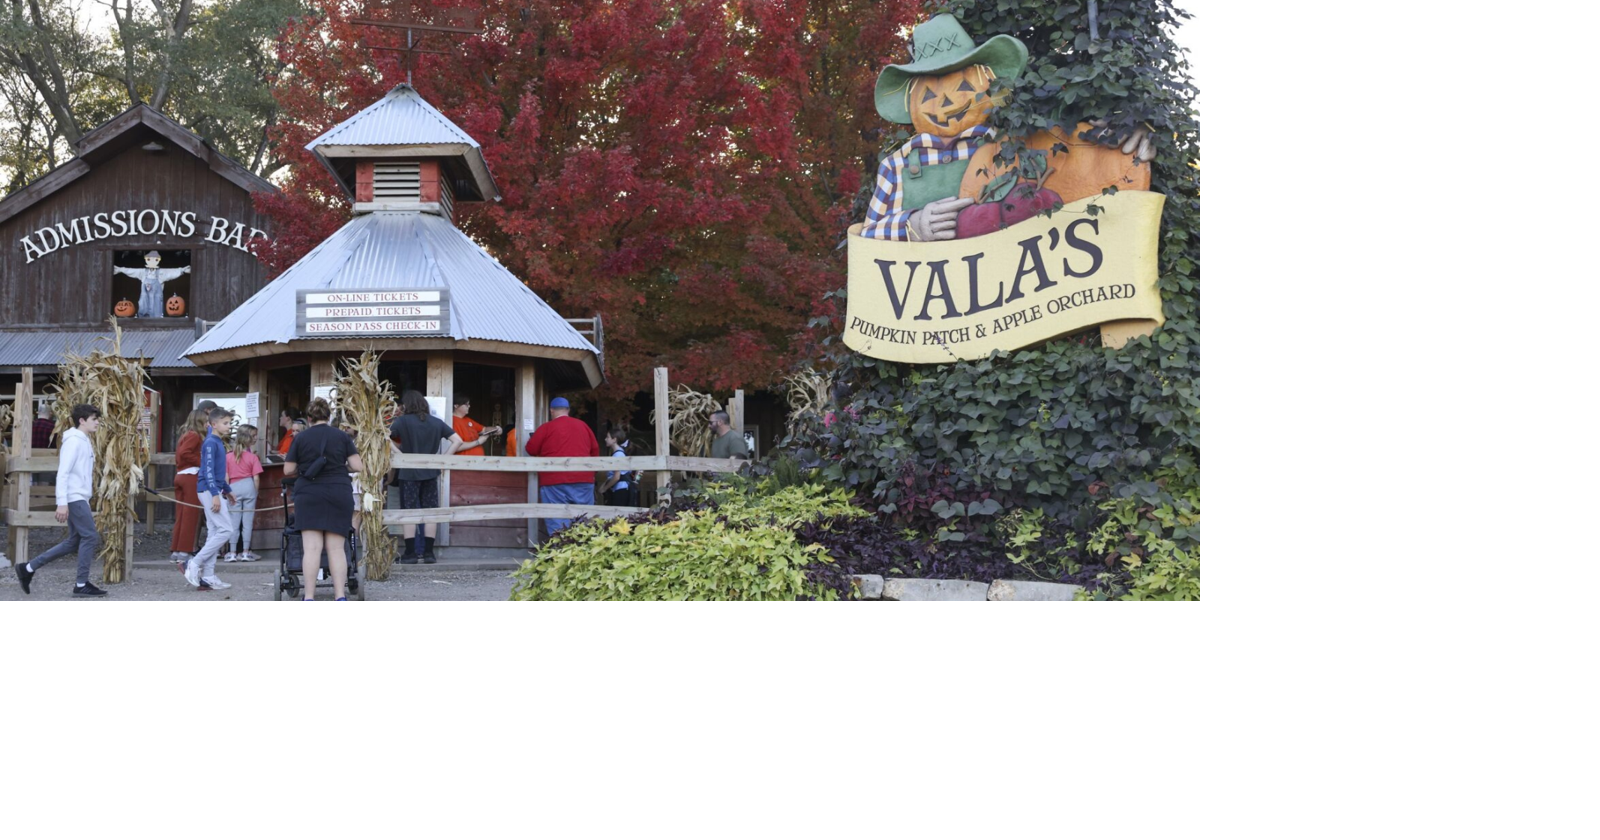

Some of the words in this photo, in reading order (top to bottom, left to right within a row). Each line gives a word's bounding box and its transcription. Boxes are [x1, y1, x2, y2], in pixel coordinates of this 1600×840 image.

[20, 209, 196, 264] ADMISSIONS
[205, 216, 278, 266] BA
[874, 218, 1104, 320] VALA'S
[325, 308, 372, 317] PREPAID
[376, 307, 421, 316] TICKETS
[327, 294, 370, 303] ON-LINE
[373, 293, 419, 301] TICKETS
[850, 316, 916, 345] PUMPKIN
[922, 326, 971, 345] PATCH
[975, 323, 987, 339] &
[992, 304, 1043, 334] APPLE
[1046, 283, 1136, 314] ORCHARD
[309, 323, 352, 332] SEASON
[355, 323, 382, 331] PASS
[385, 321, 437, 331] CHECK-IN
